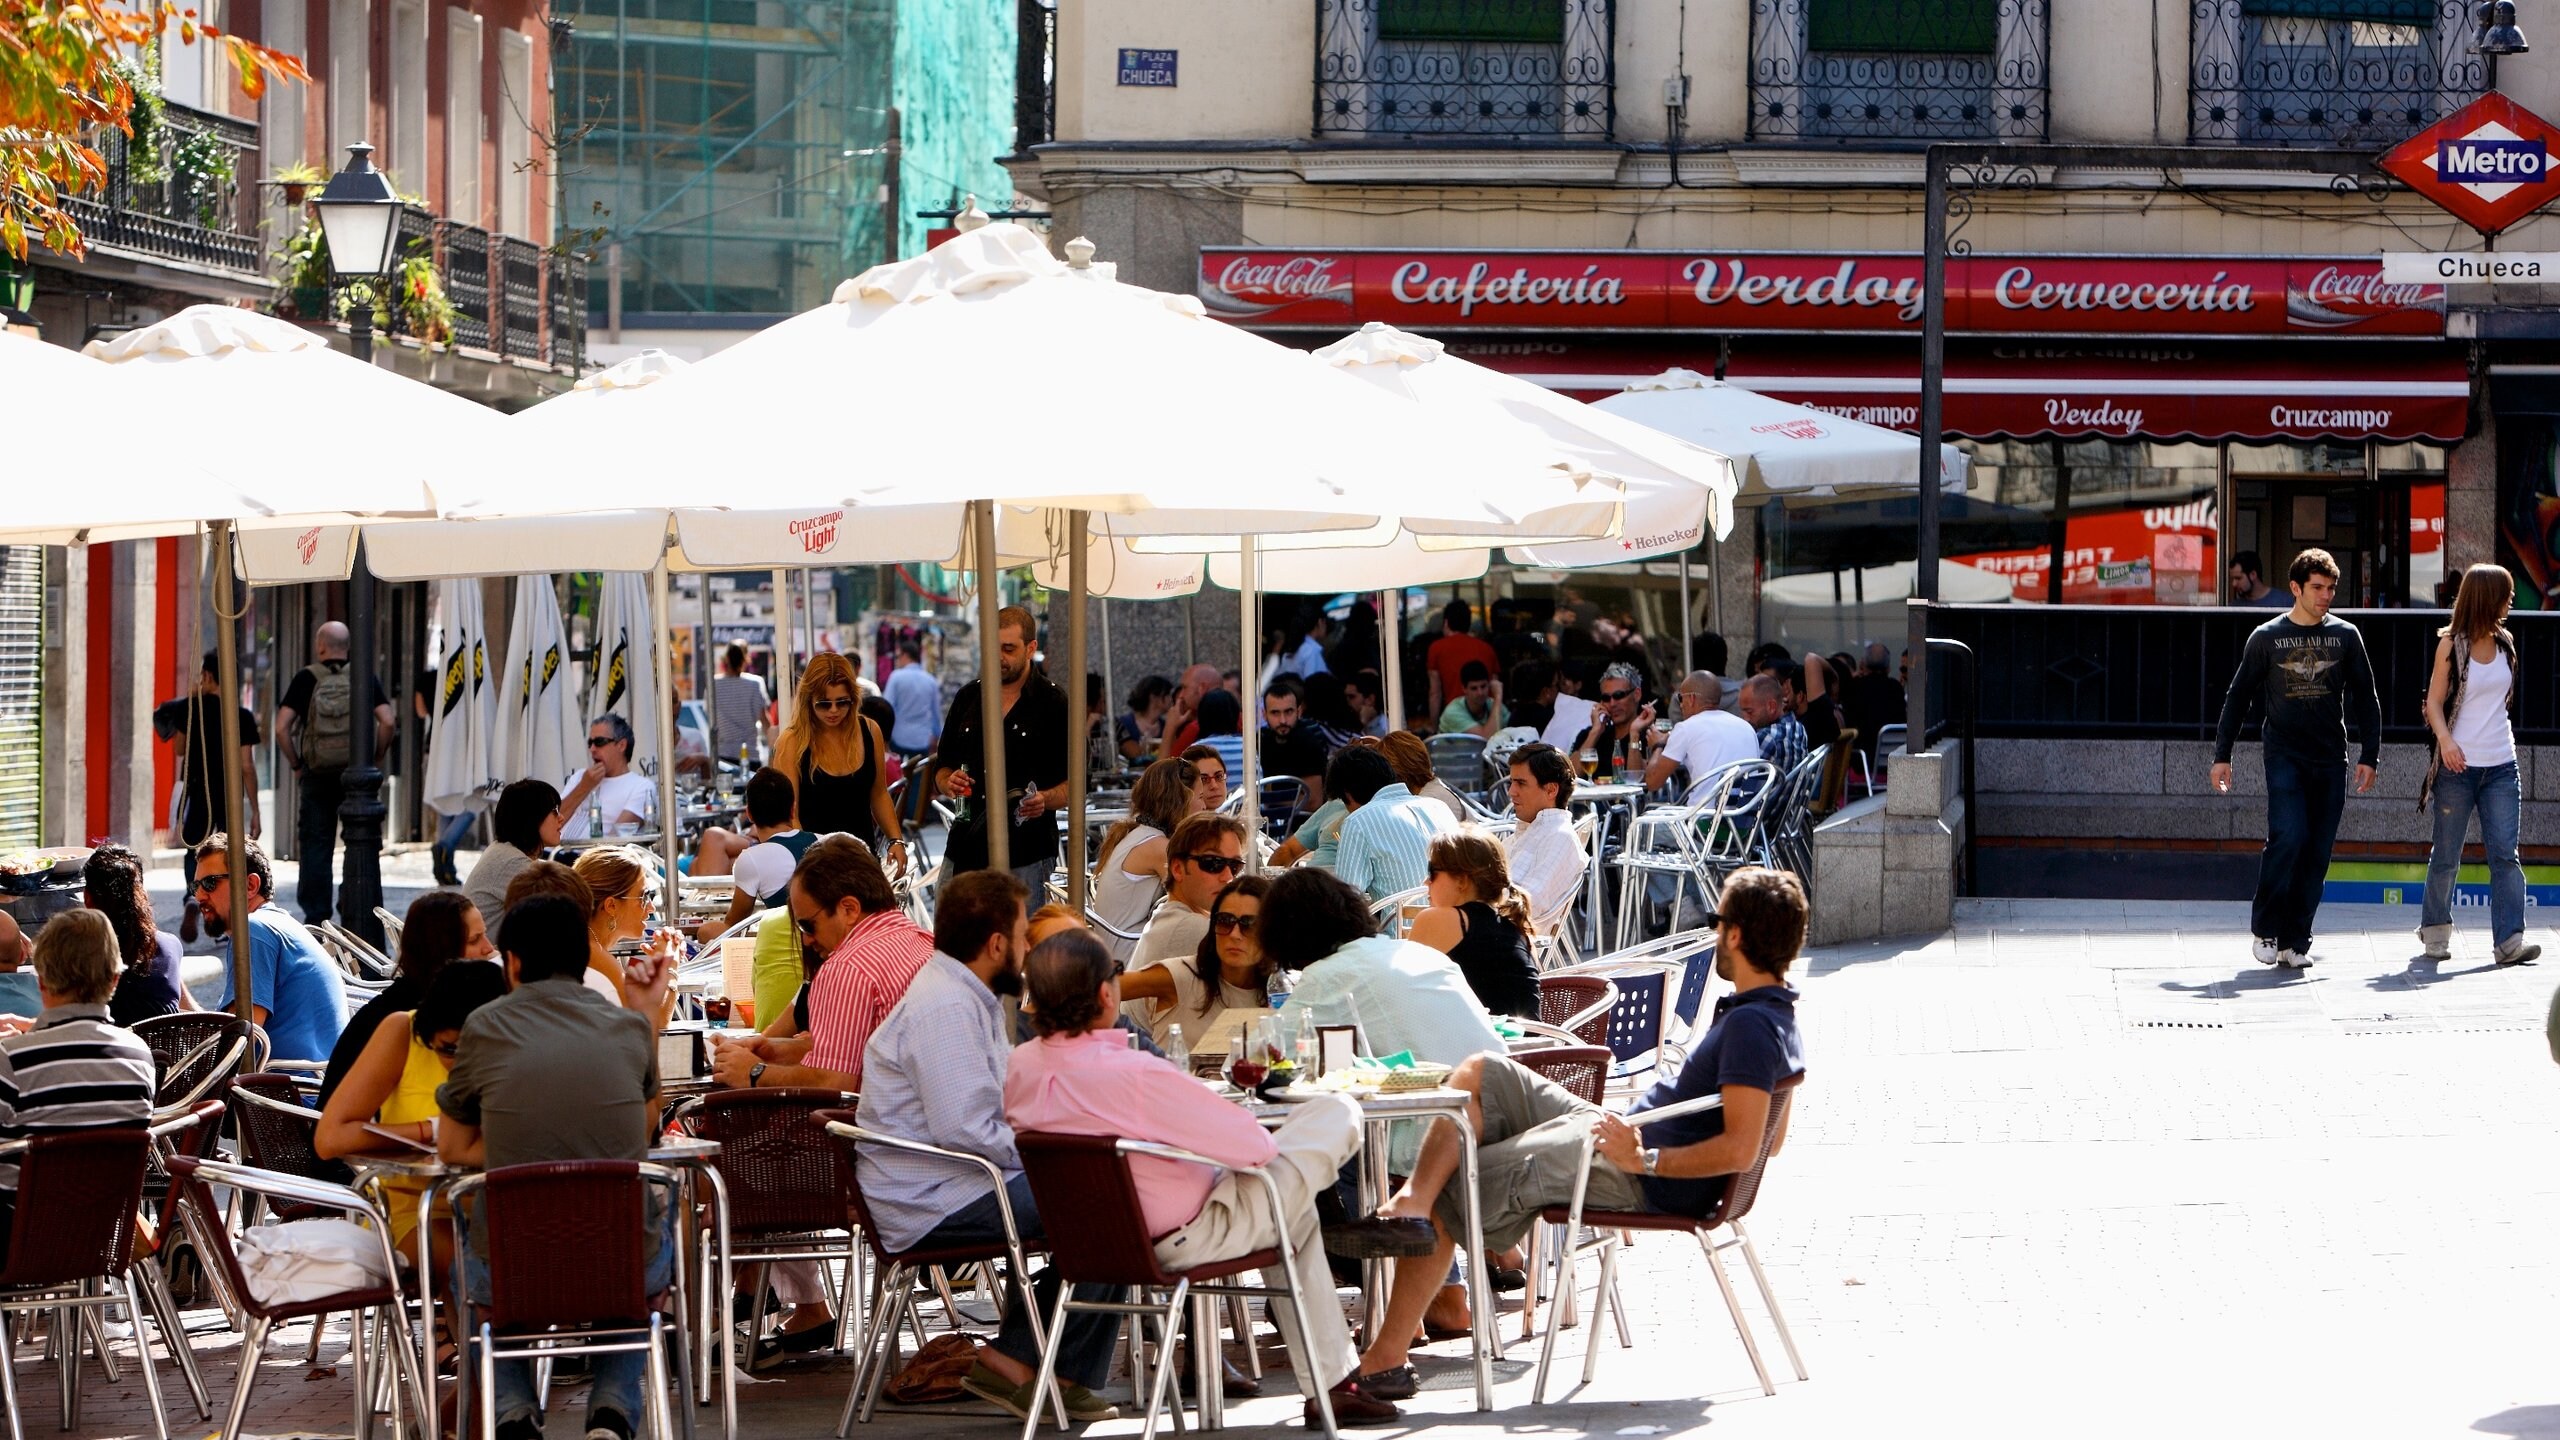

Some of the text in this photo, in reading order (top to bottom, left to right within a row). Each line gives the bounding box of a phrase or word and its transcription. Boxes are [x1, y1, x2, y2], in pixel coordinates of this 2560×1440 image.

[1141, 52, 1173, 62] PLAZA
[1121, 69, 1173, 85] CHUECA
[2447, 145, 2540, 174] Metro
[1219, 257, 1338, 295] Coca-Cola
[2438, 257, 2541, 277] Chueca
[1391, 261, 1626, 317] Cafetería
[1683, 258, 1924, 321] Verdoy
[1994, 266, 2256, 312] Cervecería
[2044, 398, 2144, 435] Verdoy
[2270, 404, 2389, 431] Cruzcampo
[788, 510, 844, 535] Cruzcampo
[805, 525, 836, 553] Light
[1634, 527, 1699, 550] Heineken
[2274, 635, 2342, 649] SCIENCE AND ARTS
[2388, 890, 2398, 904] 5
